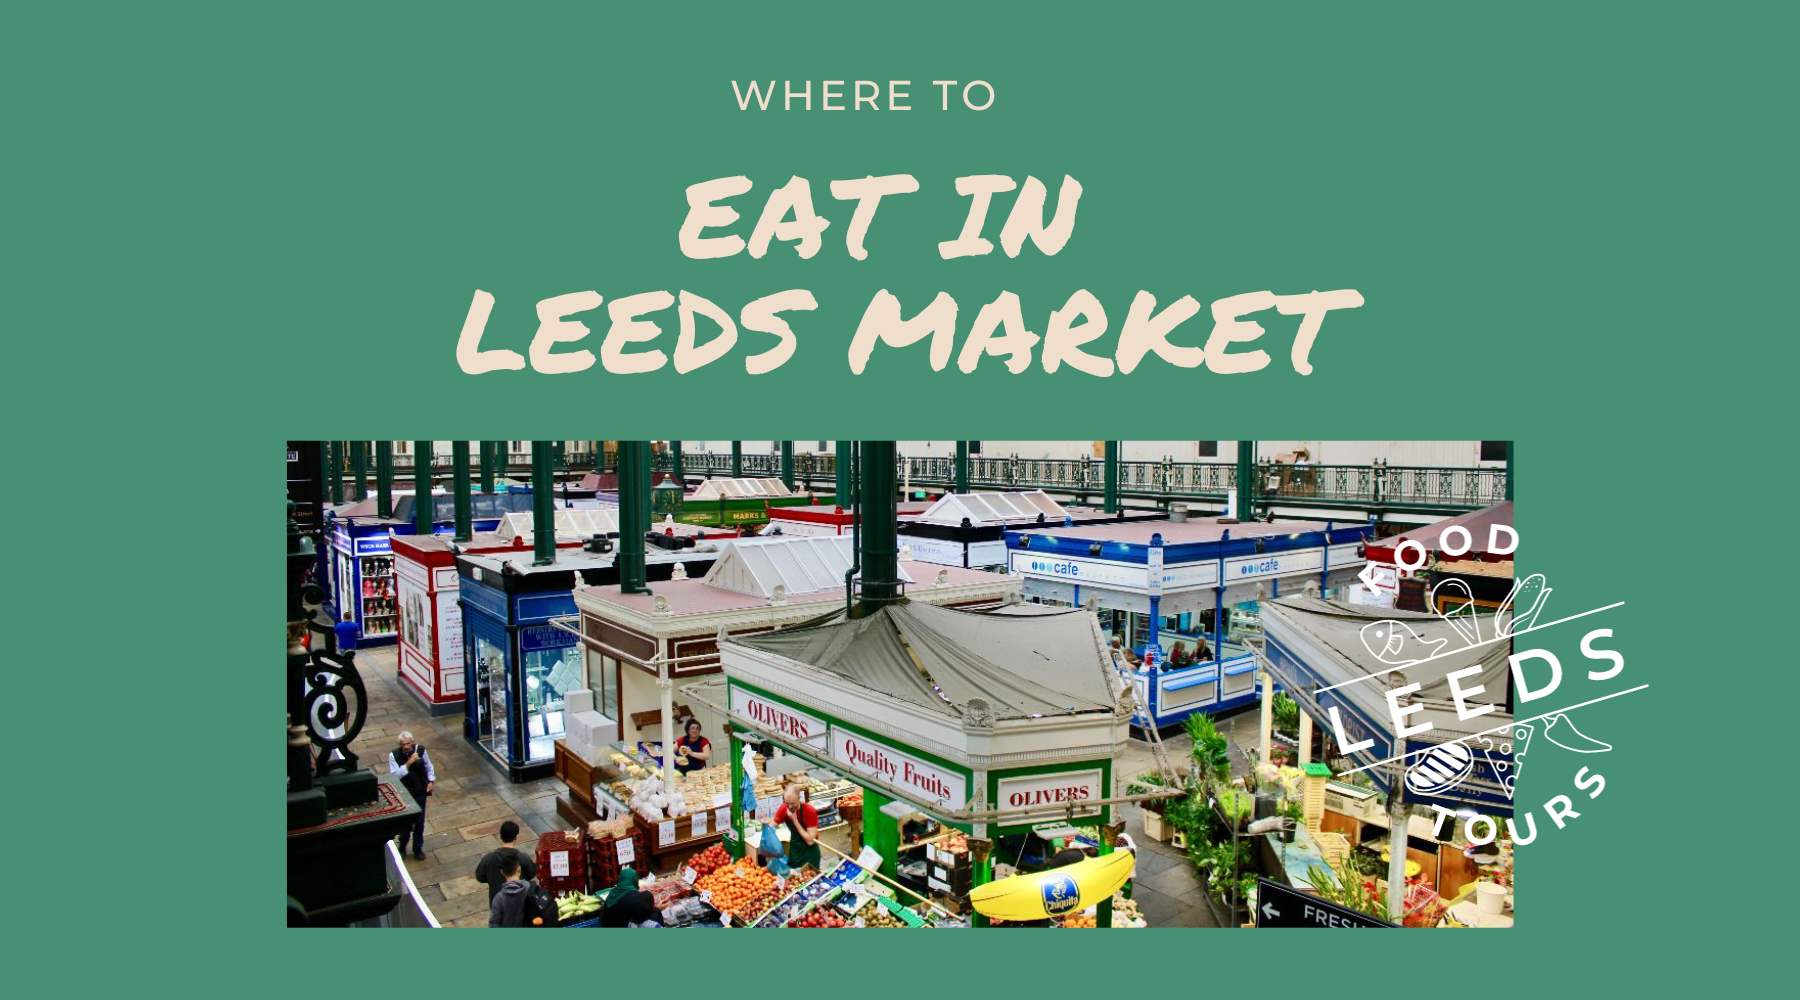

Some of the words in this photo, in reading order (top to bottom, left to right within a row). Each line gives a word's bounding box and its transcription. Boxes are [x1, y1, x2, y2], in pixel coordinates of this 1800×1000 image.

[733, 512, 759, 520] MARKS
[1054, 561, 1079, 576] cafe
[1260, 558, 1279, 572] cafe
[748, 699, 809, 739] OLIVERS
[845, 739, 898, 782] Quality
[903, 760, 951, 801] Fruits
[1009, 785, 1090, 807] OLIVERS
[1045, 895, 1079, 911] Chiquita
